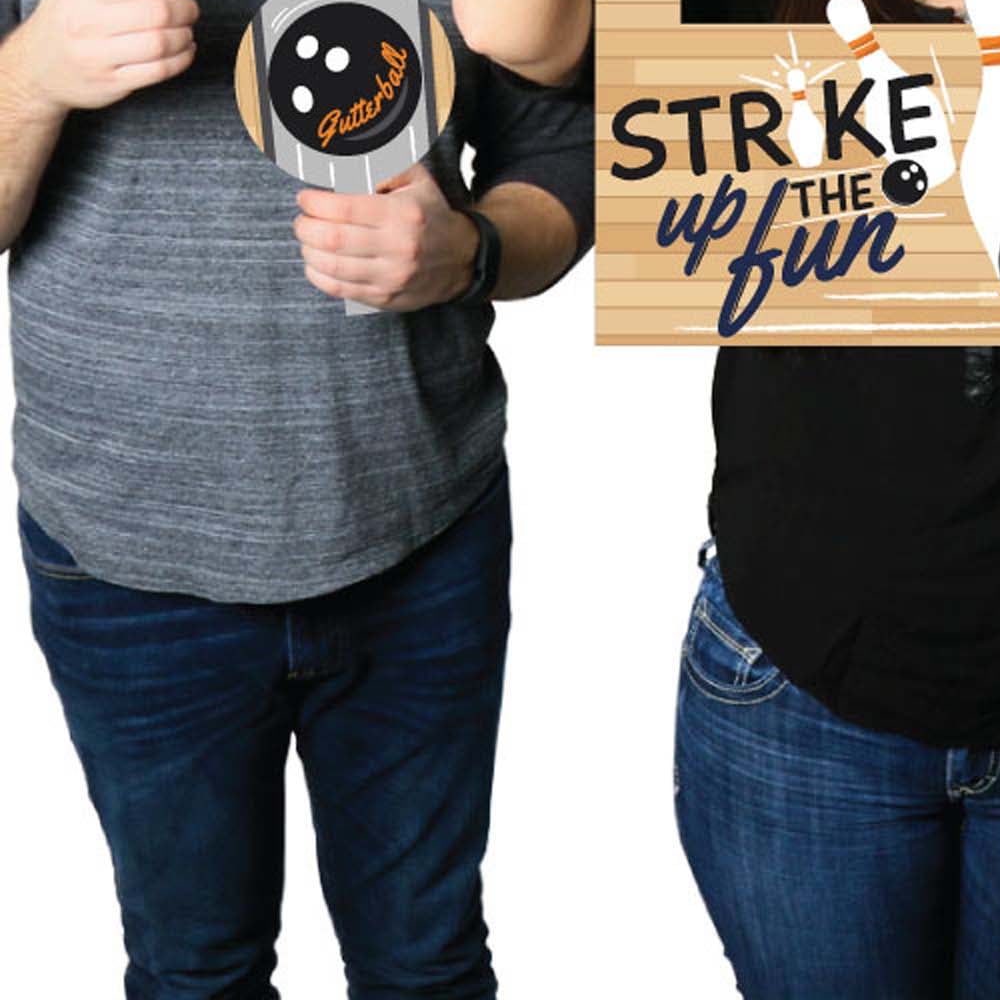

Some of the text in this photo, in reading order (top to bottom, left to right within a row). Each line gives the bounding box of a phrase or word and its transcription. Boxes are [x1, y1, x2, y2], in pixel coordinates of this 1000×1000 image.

[317, 41, 408, 147] Gutterball
[656, 173, 875, 276] up THE
[717, 177, 905, 338] fun
